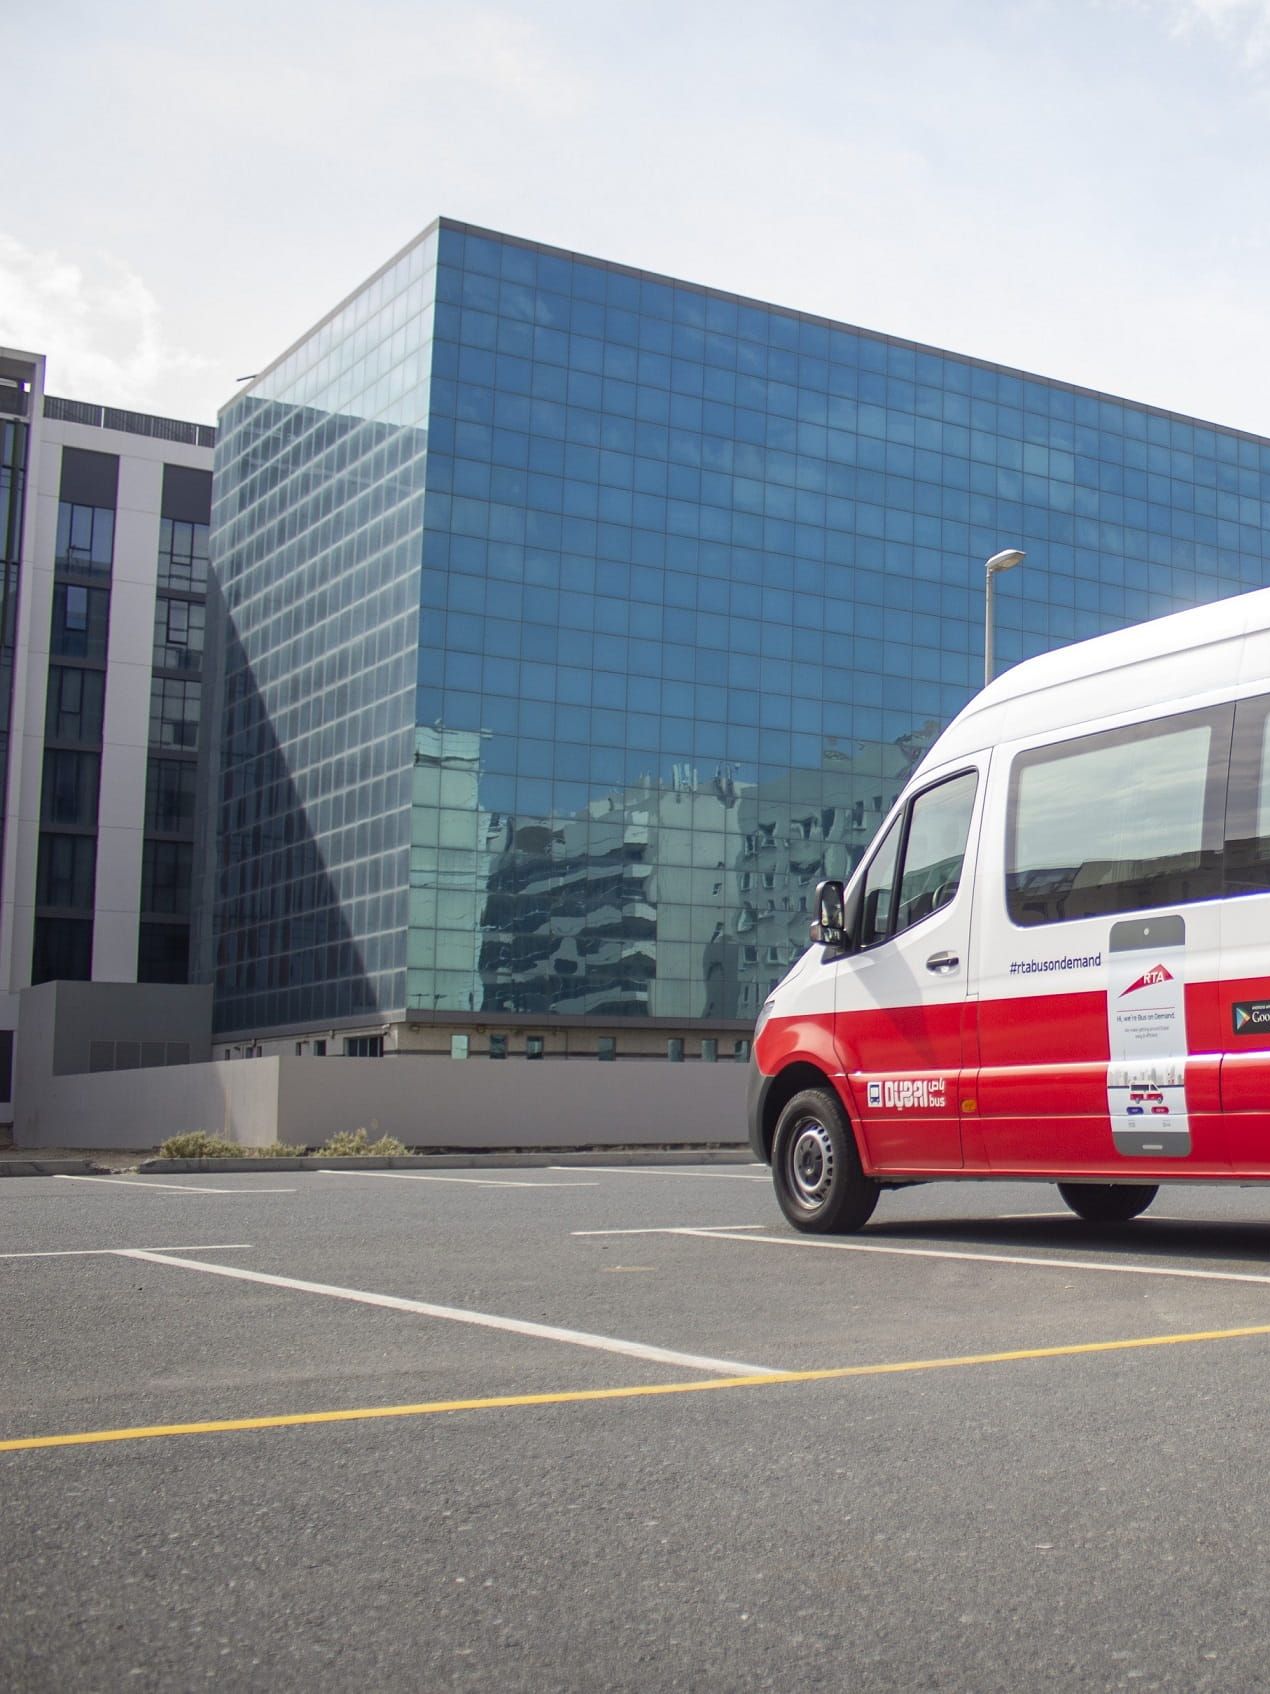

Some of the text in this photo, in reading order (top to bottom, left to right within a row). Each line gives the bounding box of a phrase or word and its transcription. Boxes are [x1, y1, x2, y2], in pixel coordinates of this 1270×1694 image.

[1010, 952, 1101, 975] #rtabusondemand
[1143, 971, 1165, 984] RTA
[929, 1095, 945, 1107] bus
